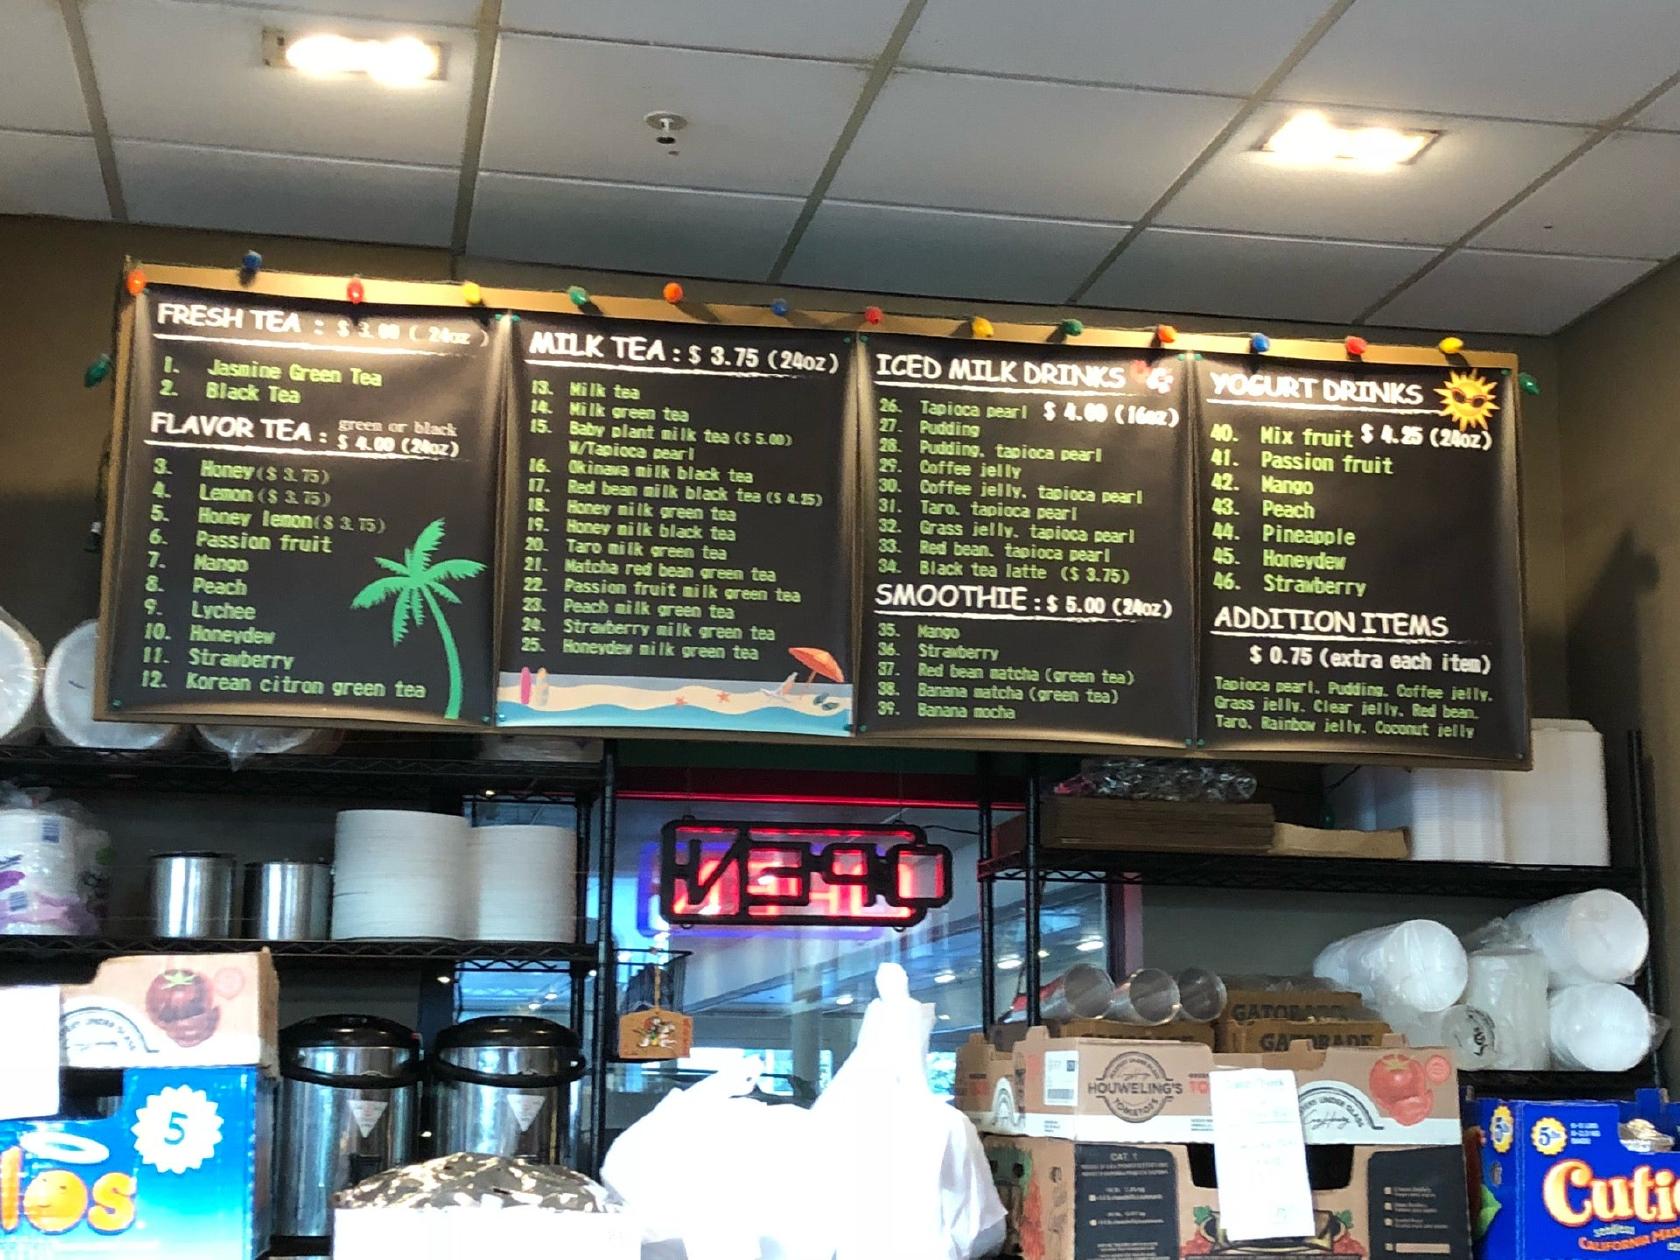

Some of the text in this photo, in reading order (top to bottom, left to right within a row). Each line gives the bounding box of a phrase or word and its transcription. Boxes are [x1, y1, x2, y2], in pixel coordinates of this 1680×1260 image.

[157, 301, 301, 333] FRESH TEA
[528, 331, 839, 374] MILK TEA 3.75 (24oz)
[207, 359, 382, 386] Jasmine Green Tea
[876, 353, 1127, 388] ICED MILK DRINKS
[206, 382, 301, 403] Black Tea
[570, 382, 640, 400] Milk tea
[1209, 372, 1424, 406] YOGURT DRINKS
[569, 402, 689, 422] Milk green tea
[920, 400, 980, 417] Tapioca
[986, 405, 1027, 419] pearl
[151, 411, 253, 438] FLAVOR
[260, 418, 312, 442] TEA
[569, 420, 697, 442] Baby plant milk
[920, 420, 980, 438] Pudding
[1261, 426, 1294, 445] Mix
[1302, 428, 1354, 448] fruit
[653, 447, 694, 461] pearl
[994, 444, 1102, 462] tapioca pearl
[1261, 451, 1394, 474] Passion fruit
[635, 464, 753, 483] milk black tea
[920, 459, 1022, 479] Coffee jelly
[601, 482, 728, 501] bean milk black
[920, 479, 1142, 504] Coffee tapioca pearl
[1261, 475, 1314, 495] Mango
[198, 507, 252, 527] Honey
[617, 503, 736, 521] milk green tea
[970, 501, 1077, 521] tapioca pearl
[1263, 500, 1315, 519] Peach
[196, 530, 332, 553] Passion fruit
[616, 522, 736, 541] milk black tea
[920, 520, 1134, 543] Grass tapioca pearl
[1263, 524, 1356, 546] Pineapple
[566, 538, 727, 560] Taro milk green tea
[920, 540, 1110, 563] Red tapioca pearl
[1263, 549, 1347, 570] Honeydew
[194, 554, 249, 573] Mango
[564, 558, 776, 582] Matcha red bean green tea
[920, 560, 1047, 579] Black tea latte
[193, 577, 248, 595] Peach
[564, 578, 801, 602] Passion fruit milk green tea
[1264, 573, 1367, 597] Strawberry
[564, 598, 735, 619] Peach milk green tea
[875, 583, 1028, 611] SMOOTHIE
[1065, 595, 1106, 614] 5.00
[192, 600, 256, 620] Lychee
[563, 619, 775, 640] Strawberry milk green tea
[918, 624, 960, 640] Mango
[1214, 606, 1449, 638] ADDITION ITEMS
[189, 624, 276, 644] Honeydew
[188, 648, 294, 670] Strawberry
[639, 641, 759, 660] milk green tea
[918, 643, 999, 661] Strawberry
[1270, 646, 1491, 675] 0.75 (extra each item)
[918, 662, 1134, 685] Red bean (green tea)
[186, 672, 426, 698] Korean citron green tea
[917, 682, 1118, 704] Banana (green tea)
[1214, 676, 1444, 699] Tapioca Coffee
[917, 701, 968, 718] Banana
[1214, 695, 1353, 714] Grass Clear
[1375, 720, 1474, 738] Coconut jelly
[1088, 1082, 1183, 1095] HOUWELING'S
[164, 1112, 188, 1145] 5
